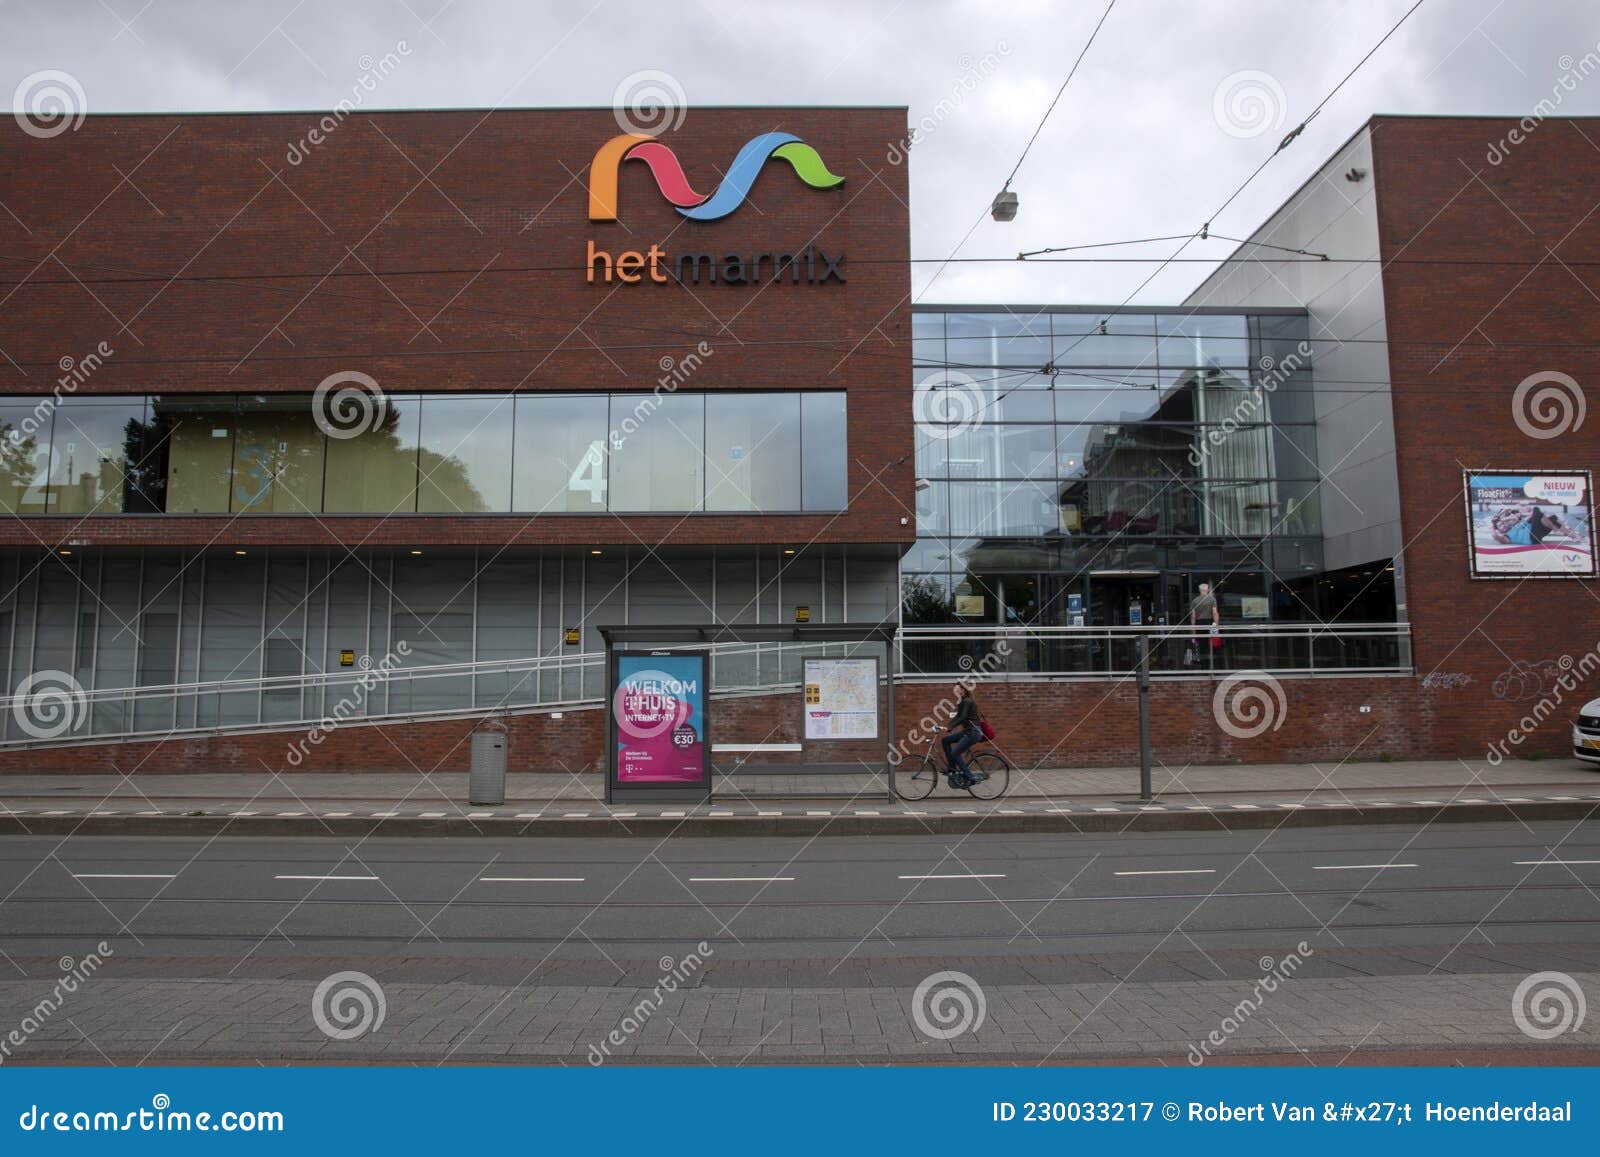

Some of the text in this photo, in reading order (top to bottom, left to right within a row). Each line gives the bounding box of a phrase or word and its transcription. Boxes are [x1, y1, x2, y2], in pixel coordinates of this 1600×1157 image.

[569, 440, 608, 503] 4
[1543, 481, 1576, 490] NIEUW
[625, 680, 697, 695] WELKOM
